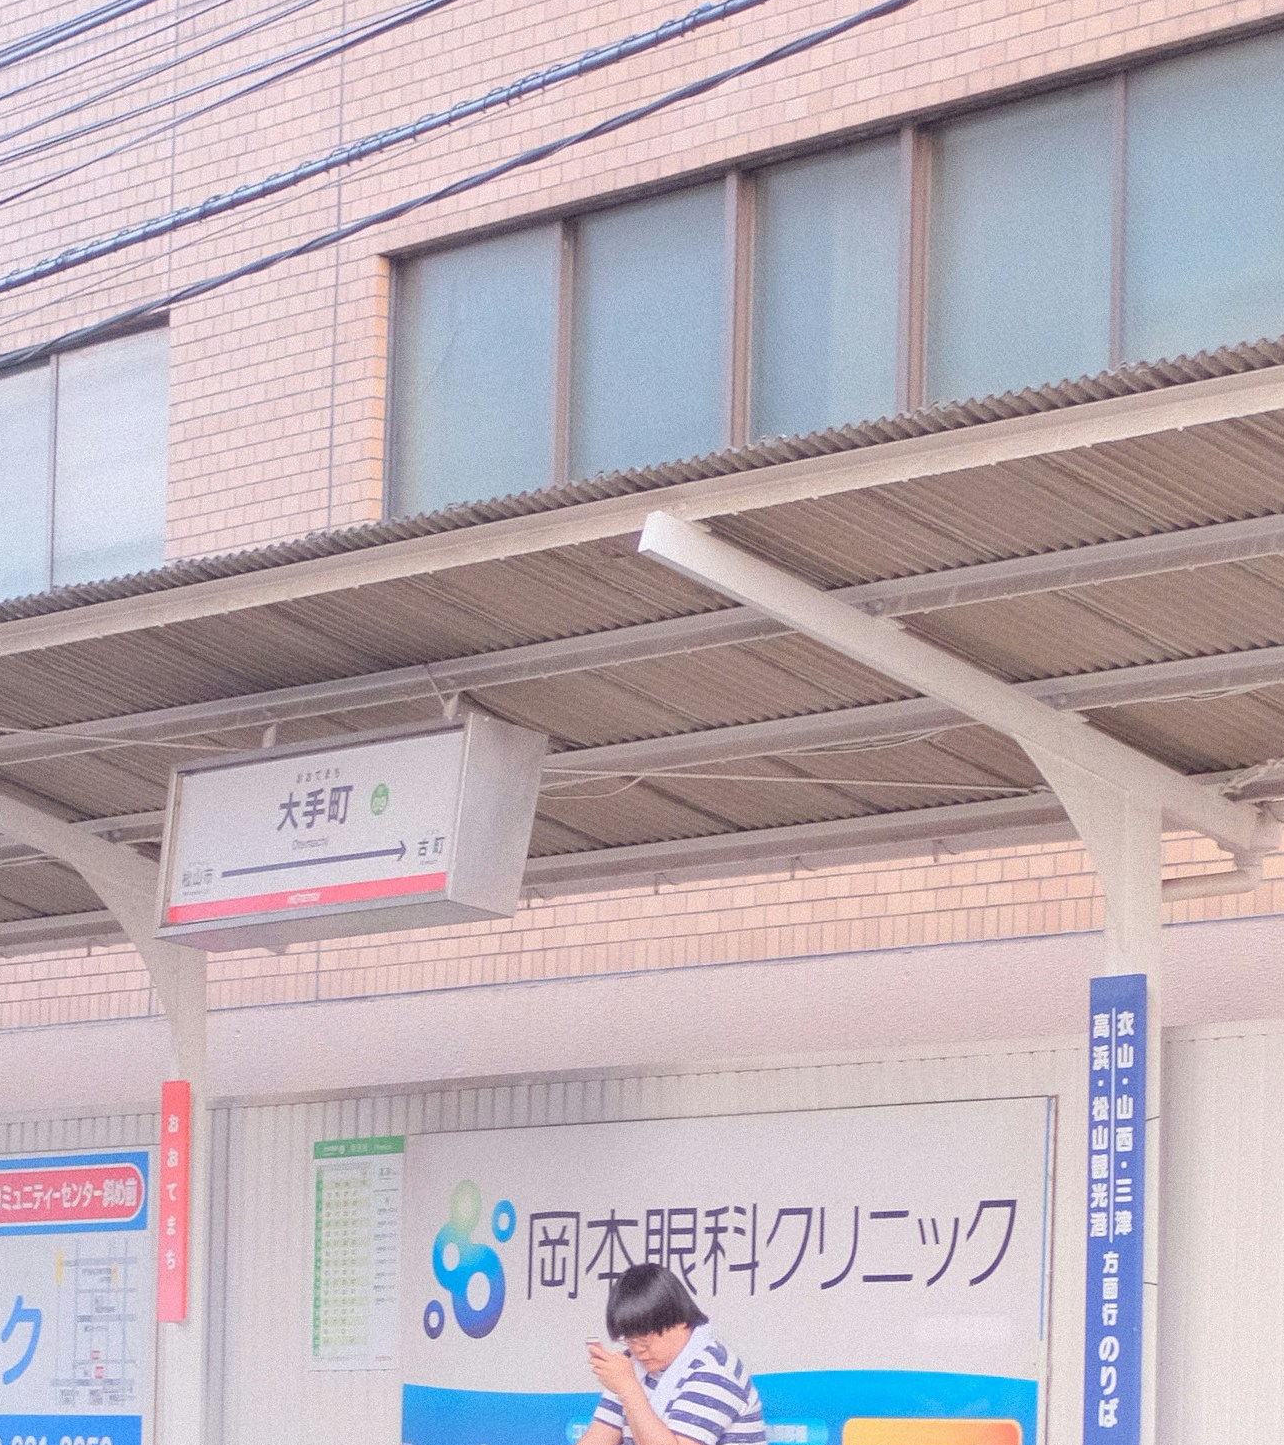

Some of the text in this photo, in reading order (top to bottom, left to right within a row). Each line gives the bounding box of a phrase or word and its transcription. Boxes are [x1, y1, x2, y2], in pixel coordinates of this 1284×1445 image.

[276, 784, 354, 832] 大手町
[165, 1114, 180, 1271] おおてまち
[1089, 1012, 1111, 1238] 高浜・松山観光港
[527, 1199, 1018, 1300] 岡本眼科クリニック
[1097, 1251, 1121, 1429] 方面行 のりば
